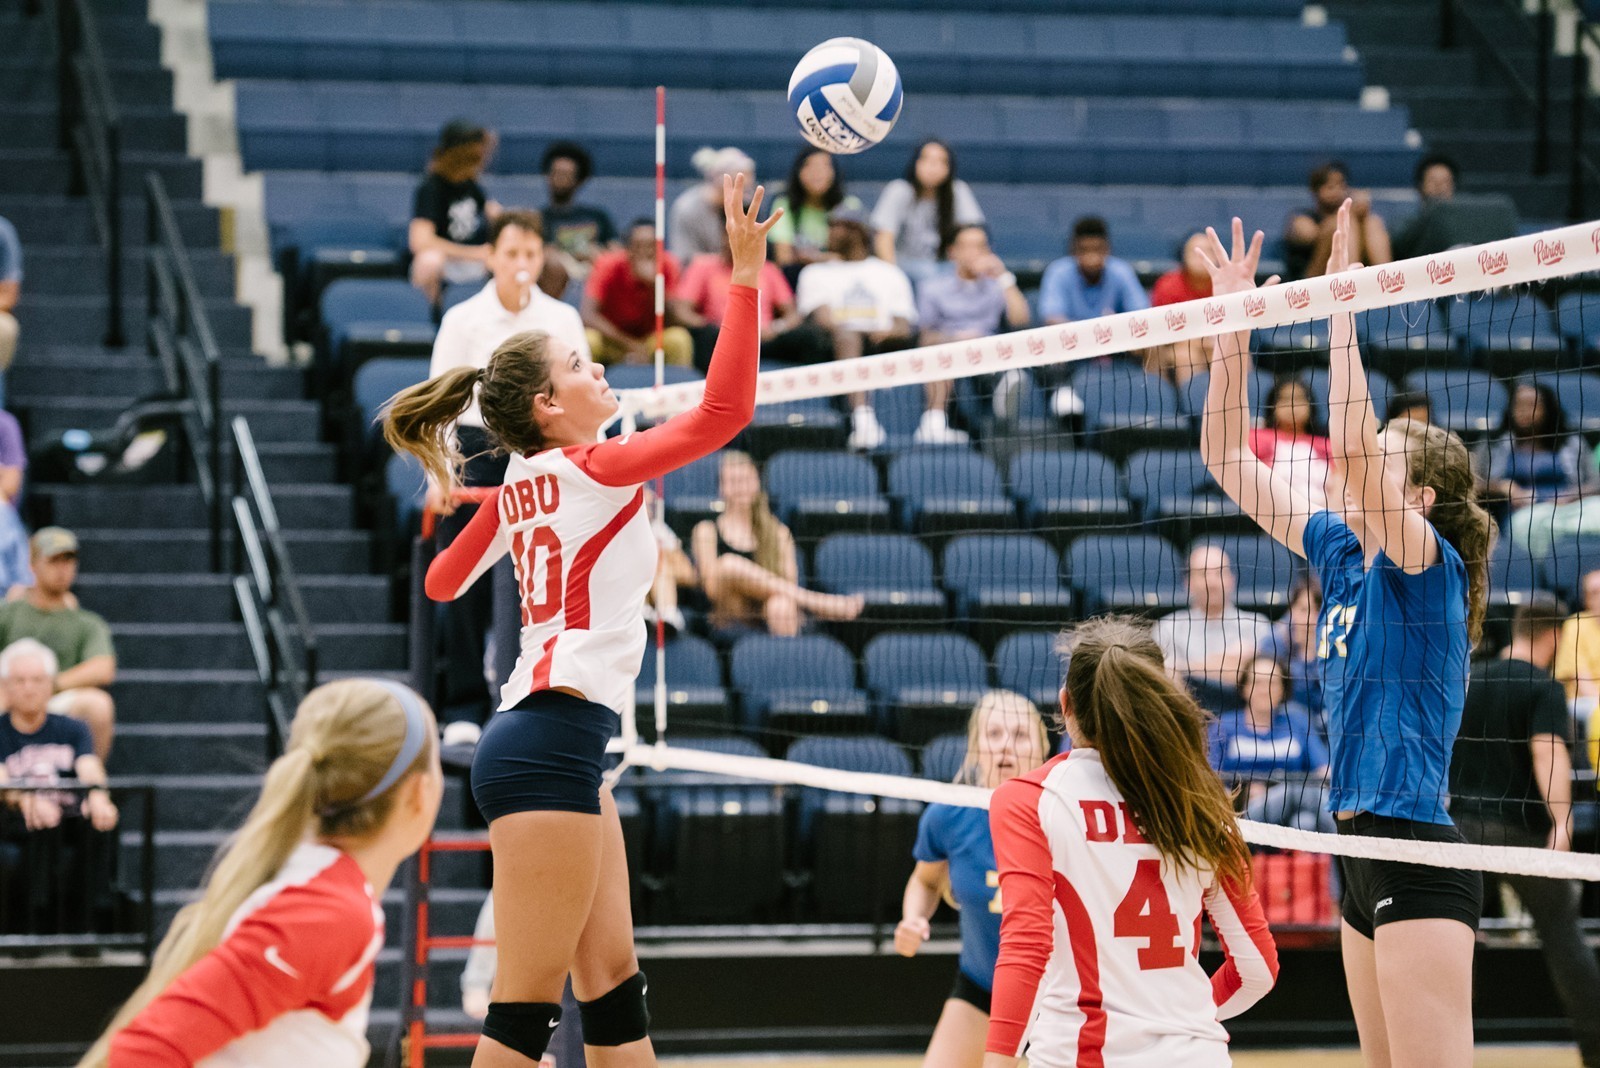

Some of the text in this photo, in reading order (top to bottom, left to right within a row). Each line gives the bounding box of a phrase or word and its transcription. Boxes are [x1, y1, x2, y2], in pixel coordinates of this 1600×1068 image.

[1285, 286, 1311, 310] Patriots
[1330, 278, 1357, 302] Patriots
[1377, 269, 1406, 294] Patriots
[1426, 260, 1456, 285] Patriots
[1478, 250, 1509, 276] Patriots
[1533, 239, 1566, 267] Patriots
[512, 525, 563, 627] 10
[1113, 859, 1186, 971] 4
